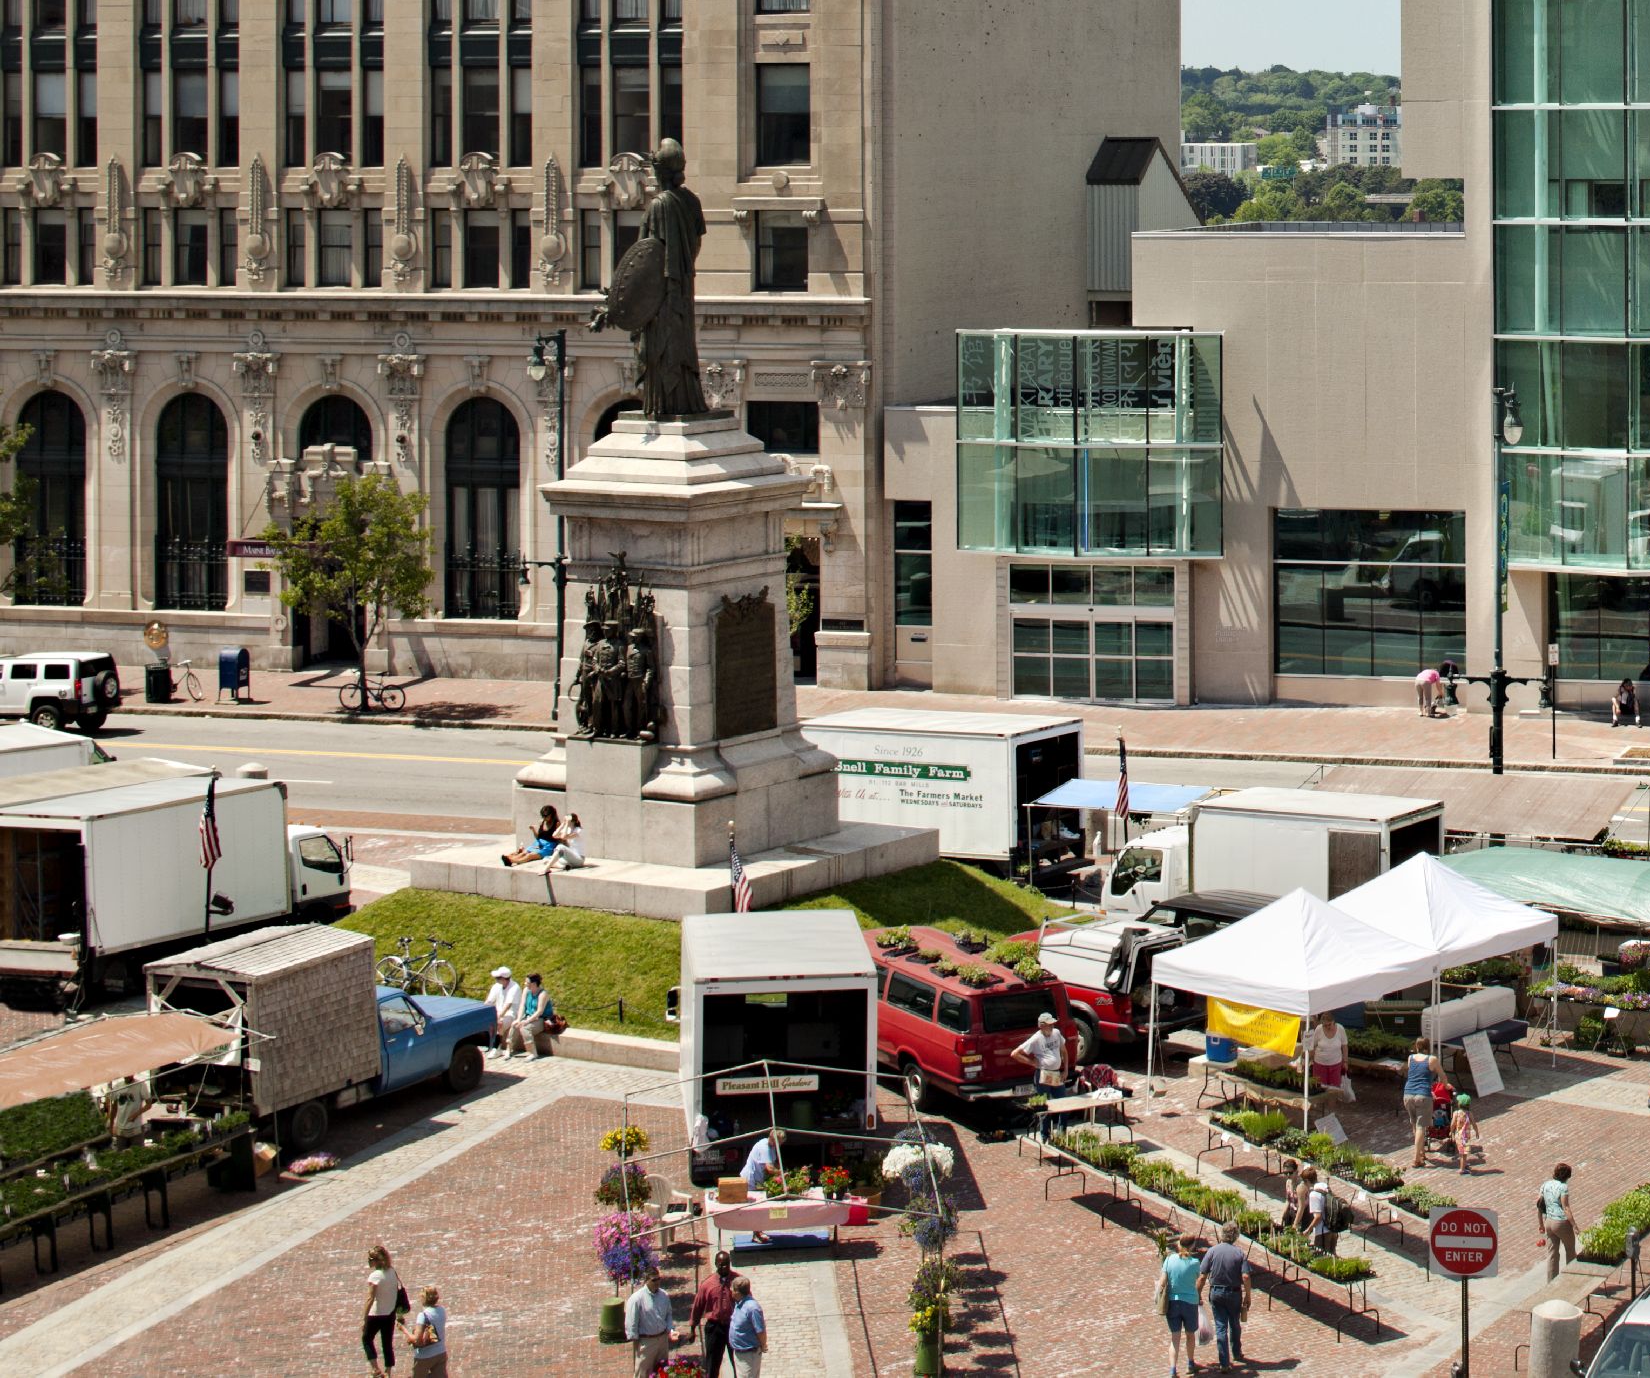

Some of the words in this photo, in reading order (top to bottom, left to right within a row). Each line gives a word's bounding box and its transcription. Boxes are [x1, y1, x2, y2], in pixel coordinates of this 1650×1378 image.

[874, 744, 899, 756] Since
[902, 746, 924, 758] 1926
[874, 763, 922, 778] Family
[928, 766, 965, 779] Farm
[899, 789, 914, 798] The
[917, 790, 950, 800] Farmers
[953, 792, 983, 802] Market
[900, 799, 940, 807] WEDNESDAYS
[949, 801, 983, 809] SATURDAYS
[721, 1081, 760, 1091] Pleasant
[761, 1078, 779, 1089] Hll
[1441, 1222, 1458, 1233] DO
[1464, 1222, 1488, 1234] NOT
[1445, 1250, 1483, 1263] ENTER
